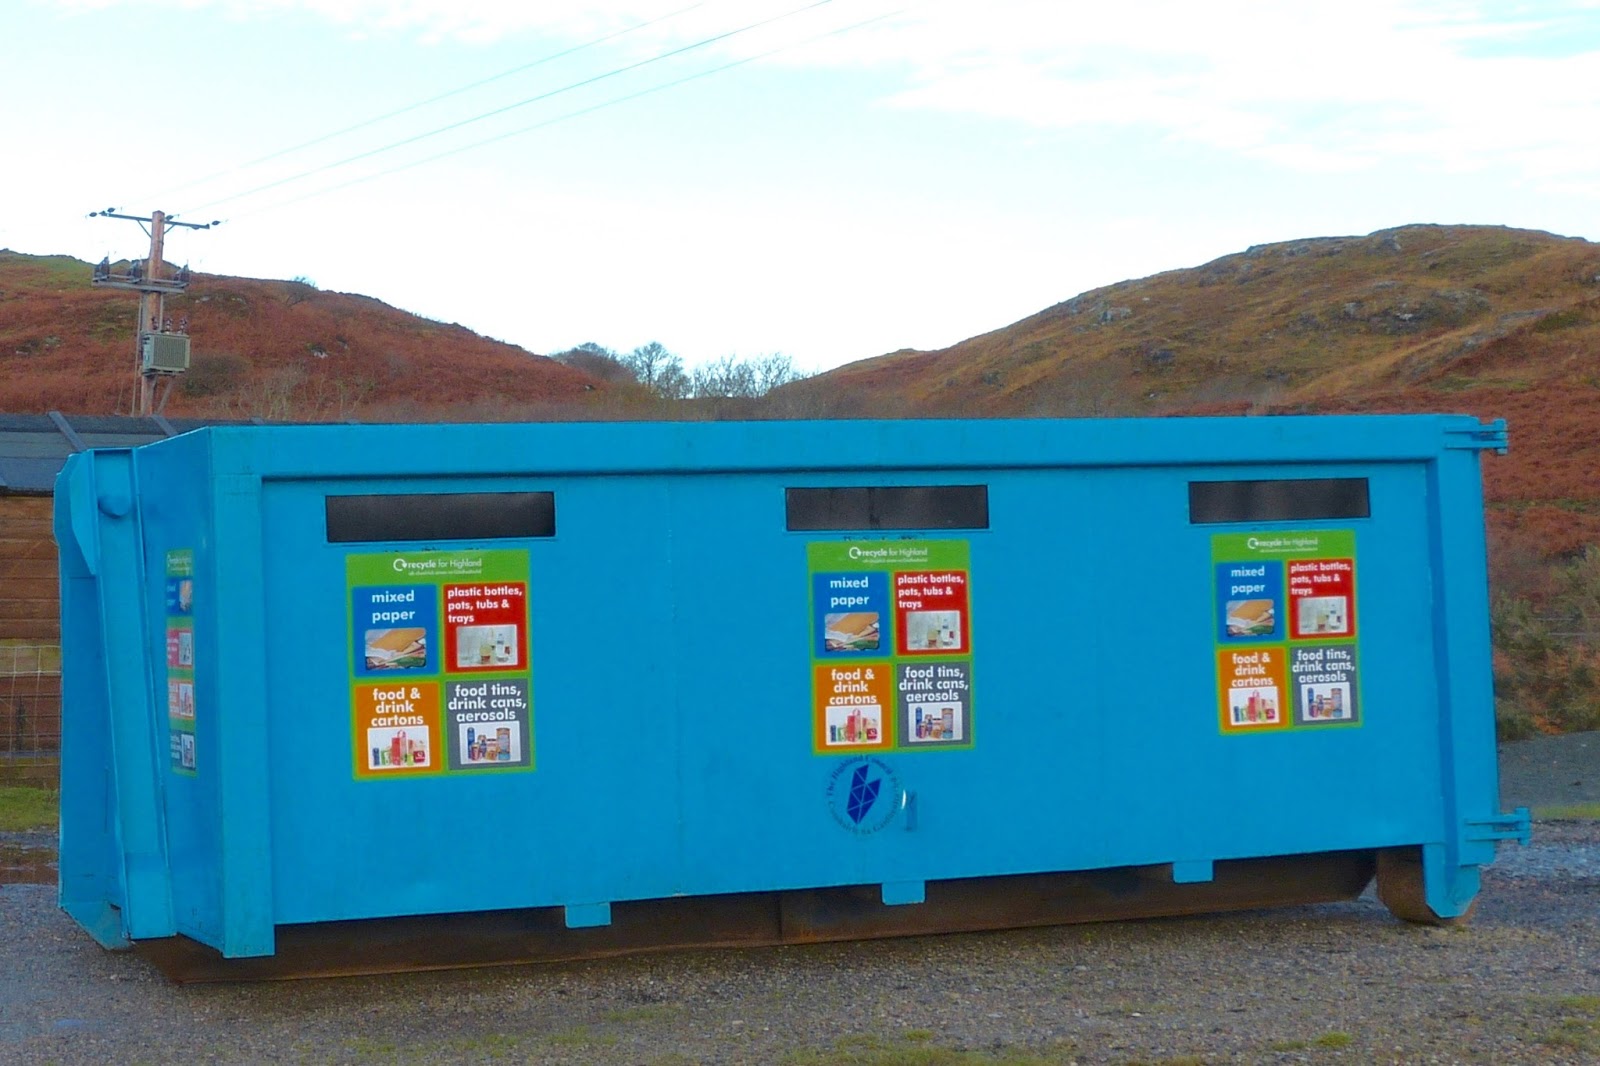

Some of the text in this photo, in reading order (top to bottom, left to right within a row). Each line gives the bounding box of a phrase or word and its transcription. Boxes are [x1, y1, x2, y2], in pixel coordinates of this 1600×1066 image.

[862, 547, 927, 558] recycle for Highland
[408, 558, 482, 570] recycle for Highland
[1291, 563, 1318, 573] plastic
[1231, 566, 1265, 577] mixed
[830, 576, 869, 588] mixed
[898, 574, 964, 585] plastic bottles,
[1333, 574, 1340, 582] &
[448, 586, 523, 599] plastic bottles,
[898, 587, 953, 597] pots, tubs &
[1231, 584, 1265, 595] paper
[1291, 587, 1312, 596] trays
[372, 590, 414, 603] mixed
[831, 595, 869, 608] paper
[448, 599, 510, 612] pots, tubs &
[899, 600, 922, 609] trays
[372, 610, 415, 623] paper
[448, 614, 474, 623] trays
[1232, 652, 1270, 664] food &
[1297, 649, 1350, 661] food tins,
[905, 666, 964, 678] food tins,
[1235, 664, 1266, 676] drink
[1292, 661, 1355, 673] drink cans,
[831, 669, 874, 681] food &
[1299, 671, 1347, 683] aerosols
[834, 681, 868, 693] drink
[899, 678, 969, 691] drink cans,
[1231, 677, 1274, 687] cartons
[373, 687, 420, 700] food &
[455, 683, 521, 697] food tins,
[906, 689, 959, 702] aerosols
[448, 697, 527, 711] drink cans,
[829, 694, 877, 705] cartons
[376, 700, 414, 714] drink
[371, 714, 424, 727] cartons
[456, 708, 516, 722] aerosols
